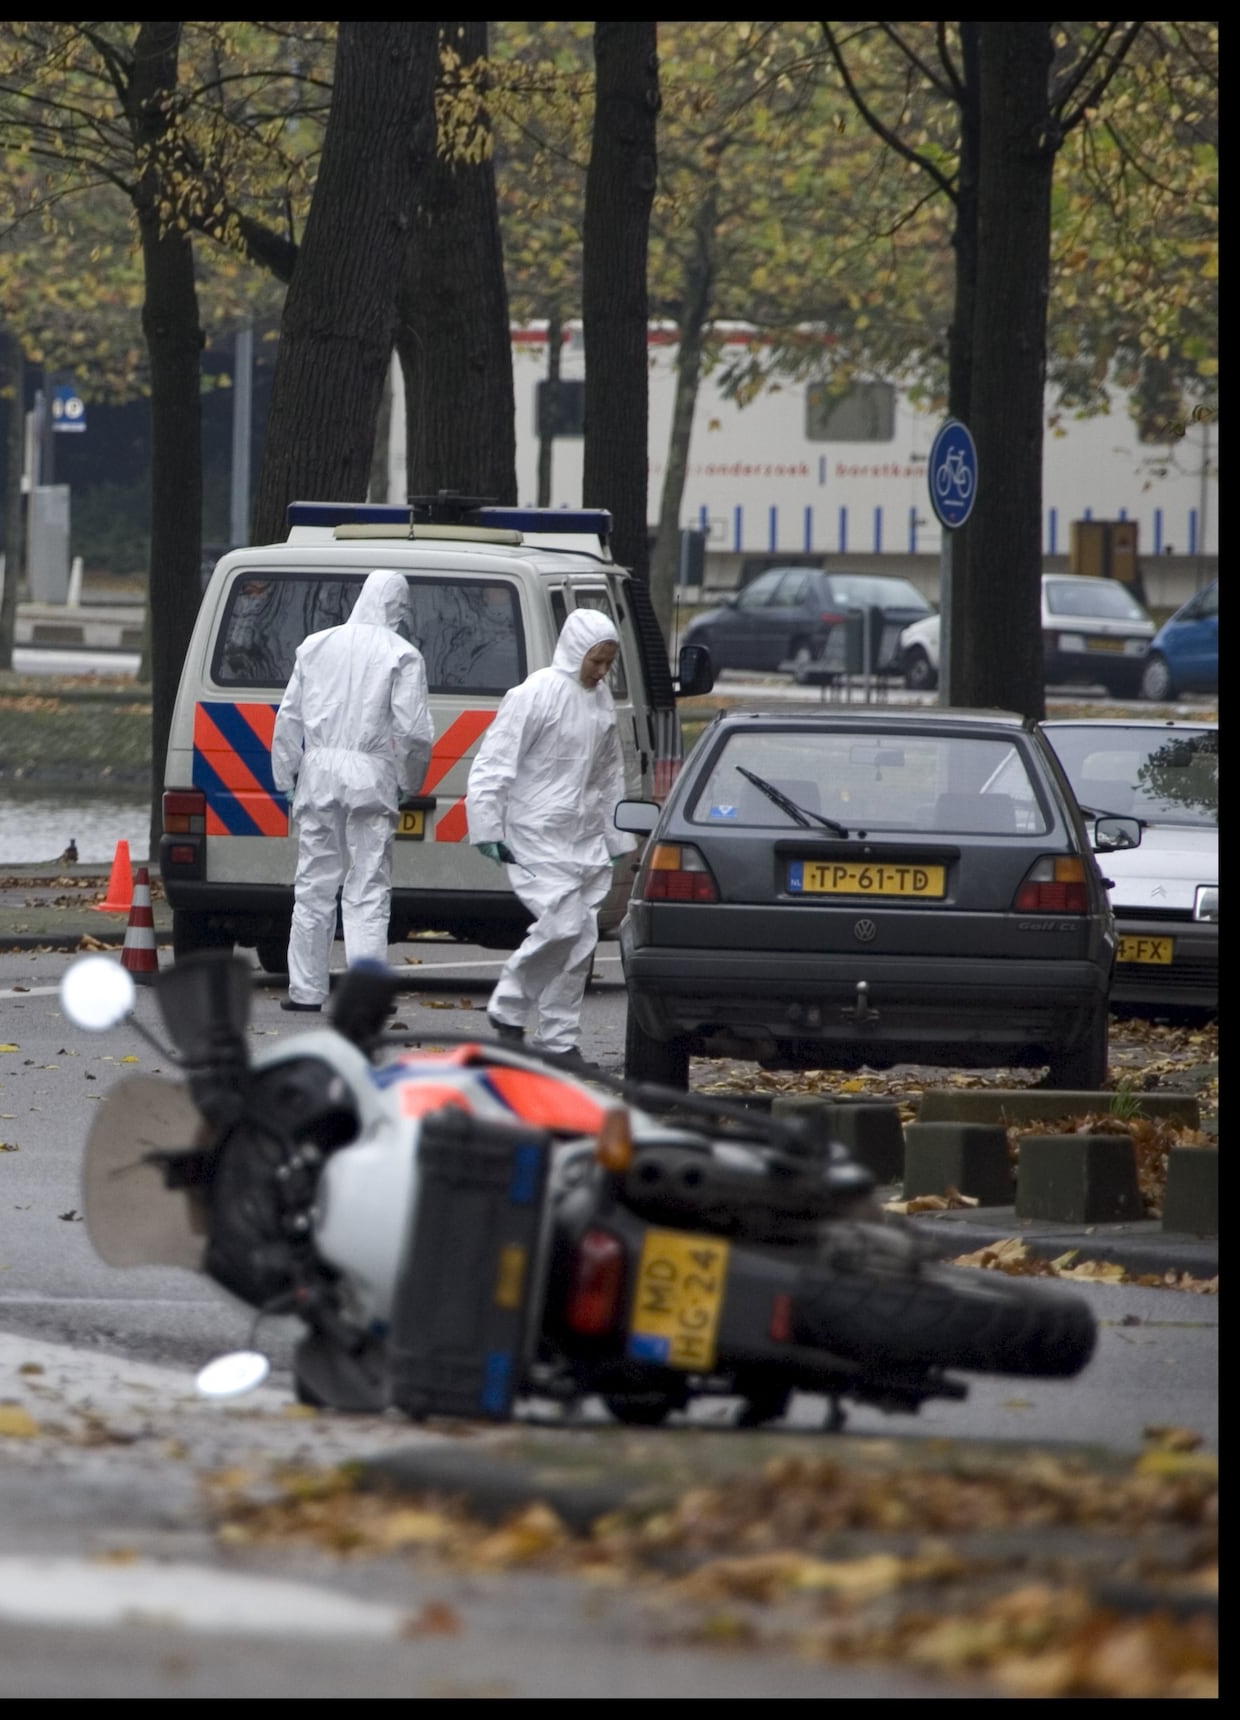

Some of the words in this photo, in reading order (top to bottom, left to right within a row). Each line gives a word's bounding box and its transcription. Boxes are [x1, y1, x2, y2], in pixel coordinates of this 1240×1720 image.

[790, 879, 801, 887] NL
[815, 865, 929, 891] TP-61-TD
[1117, 939, 1163, 960] 4-FX
[642, 1258, 678, 1314] MD
